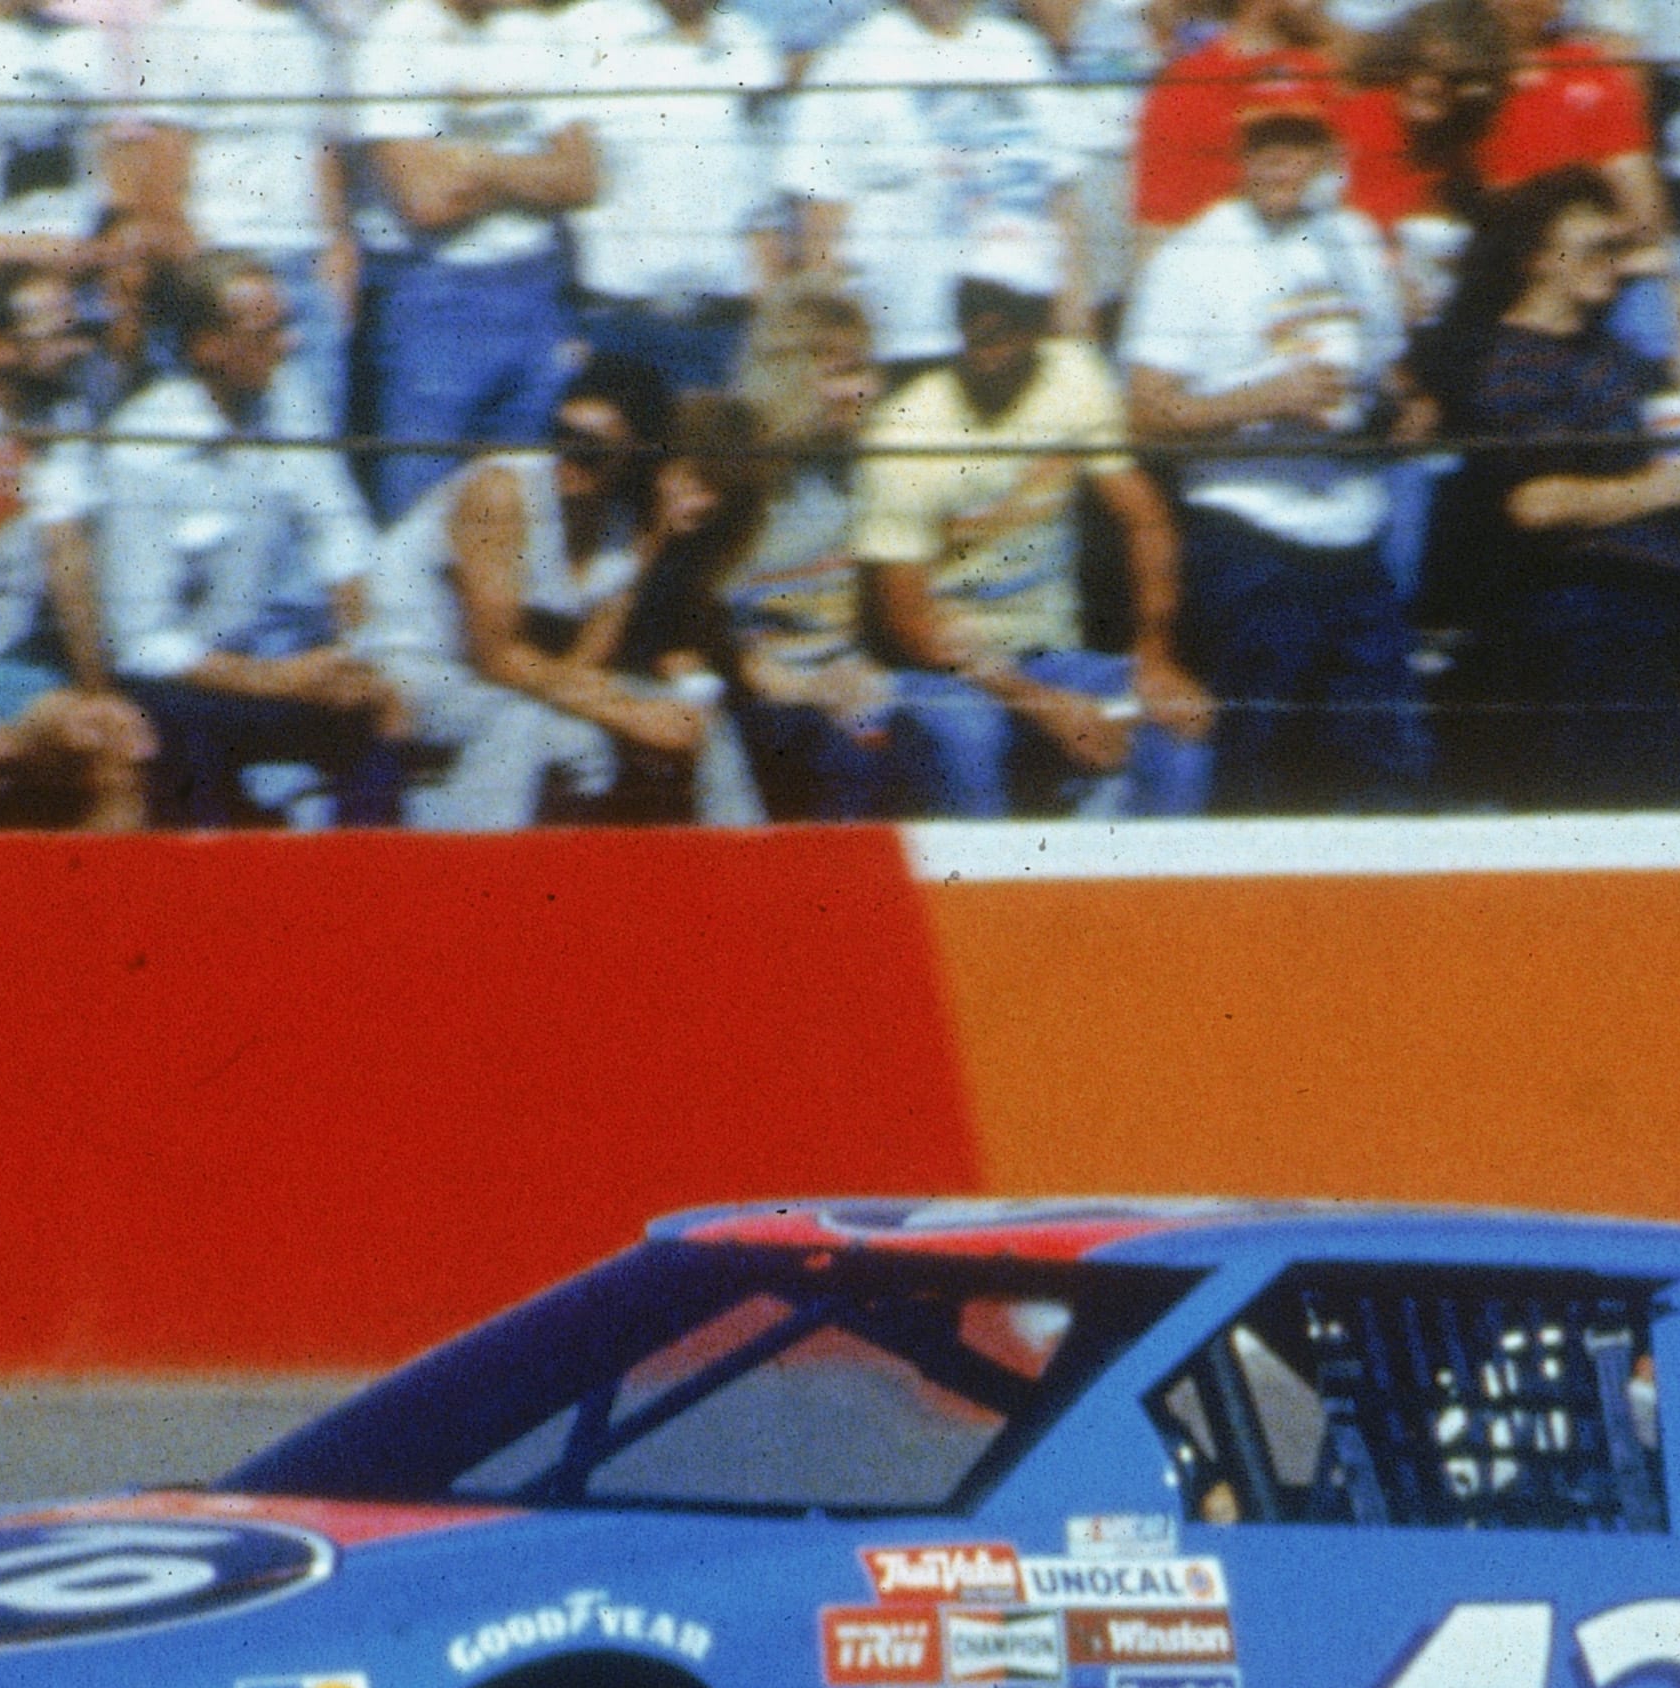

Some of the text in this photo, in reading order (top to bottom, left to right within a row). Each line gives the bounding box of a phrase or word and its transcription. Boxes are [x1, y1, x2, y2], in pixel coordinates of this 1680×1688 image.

[1030, 1567, 1186, 1596] UNOCAL
[448, 1589, 713, 1674] GOODYEAR
[834, 1623, 930, 1670] TRW
[1107, 1618, 1232, 1654] Winston
